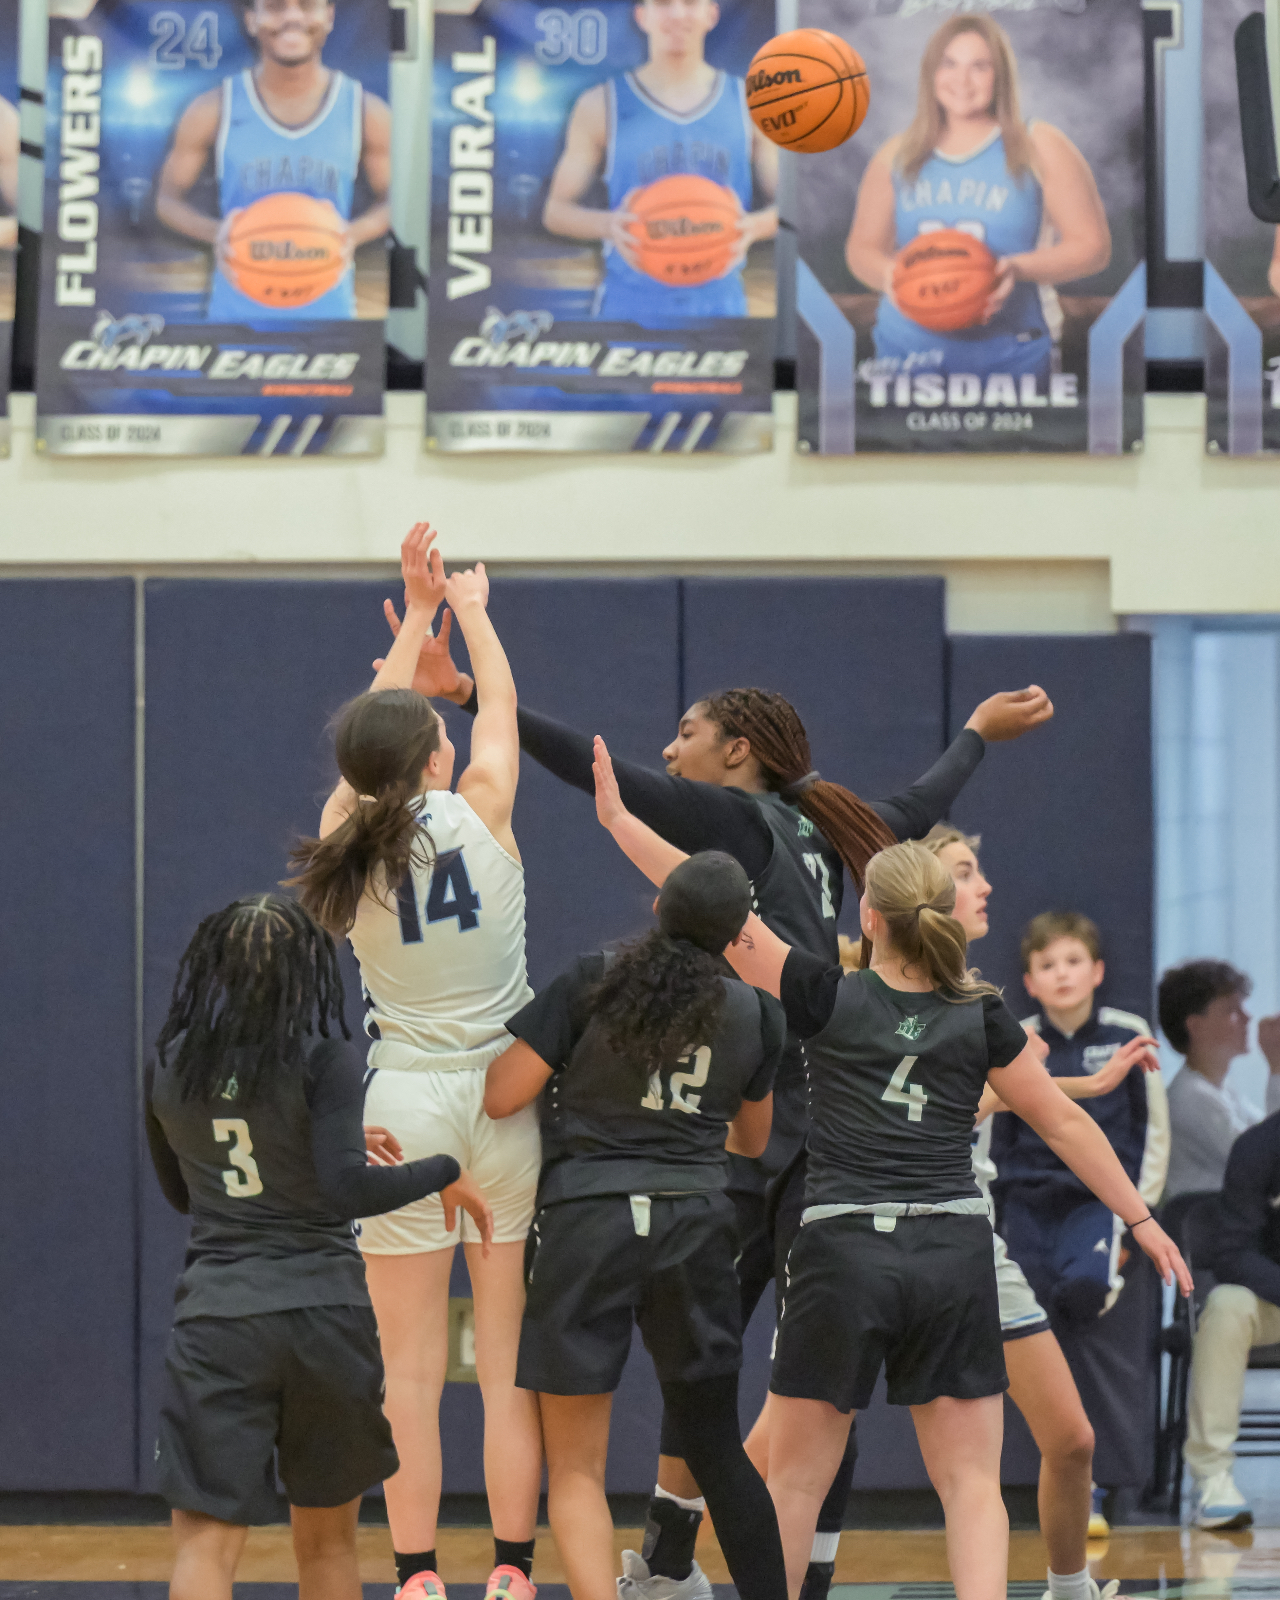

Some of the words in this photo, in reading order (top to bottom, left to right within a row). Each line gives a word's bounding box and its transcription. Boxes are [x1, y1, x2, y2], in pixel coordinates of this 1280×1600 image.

[149, 10, 222, 70] 24
[535, 8, 607, 65] 30
[56, 35, 102, 306] FLOWERS
[447, 36, 496, 300] VEDRAL
[60, 340, 212, 371] CHAPIN
[207, 350, 360, 380] EAGLES
[450, 337, 601, 368] CHAPIN
[597, 347, 749, 378] EAGLES
[867, 372, 1080, 409] TISDALE
[906, 411, 961, 432] CLASS
[963, 411, 988, 432] OF
[396, 847, 482, 945] 14
[641, 1045, 712, 1115] 12
[881, 1055, 928, 1122] 4
[212, 1118, 264, 1198] 3
